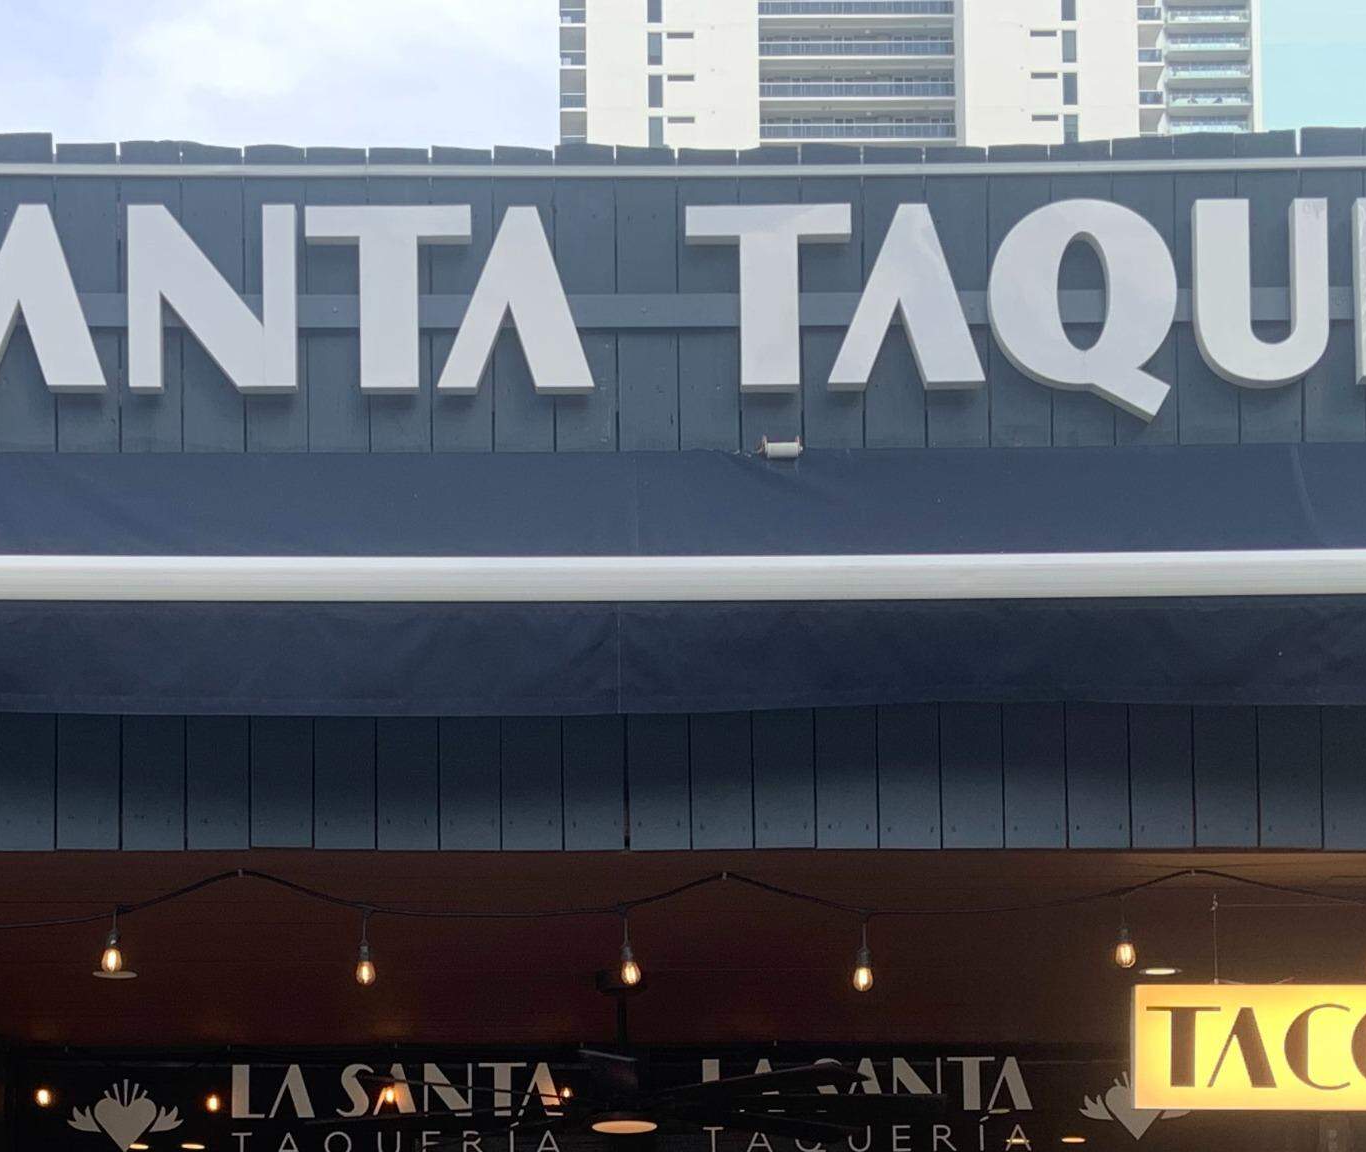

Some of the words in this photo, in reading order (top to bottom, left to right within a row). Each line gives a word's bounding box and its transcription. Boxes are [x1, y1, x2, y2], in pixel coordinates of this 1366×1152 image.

[232, 1063, 316, 1119] LA
[336, 1062, 565, 1118] SANTA
[813, 1056, 1033, 1112] ANTA
